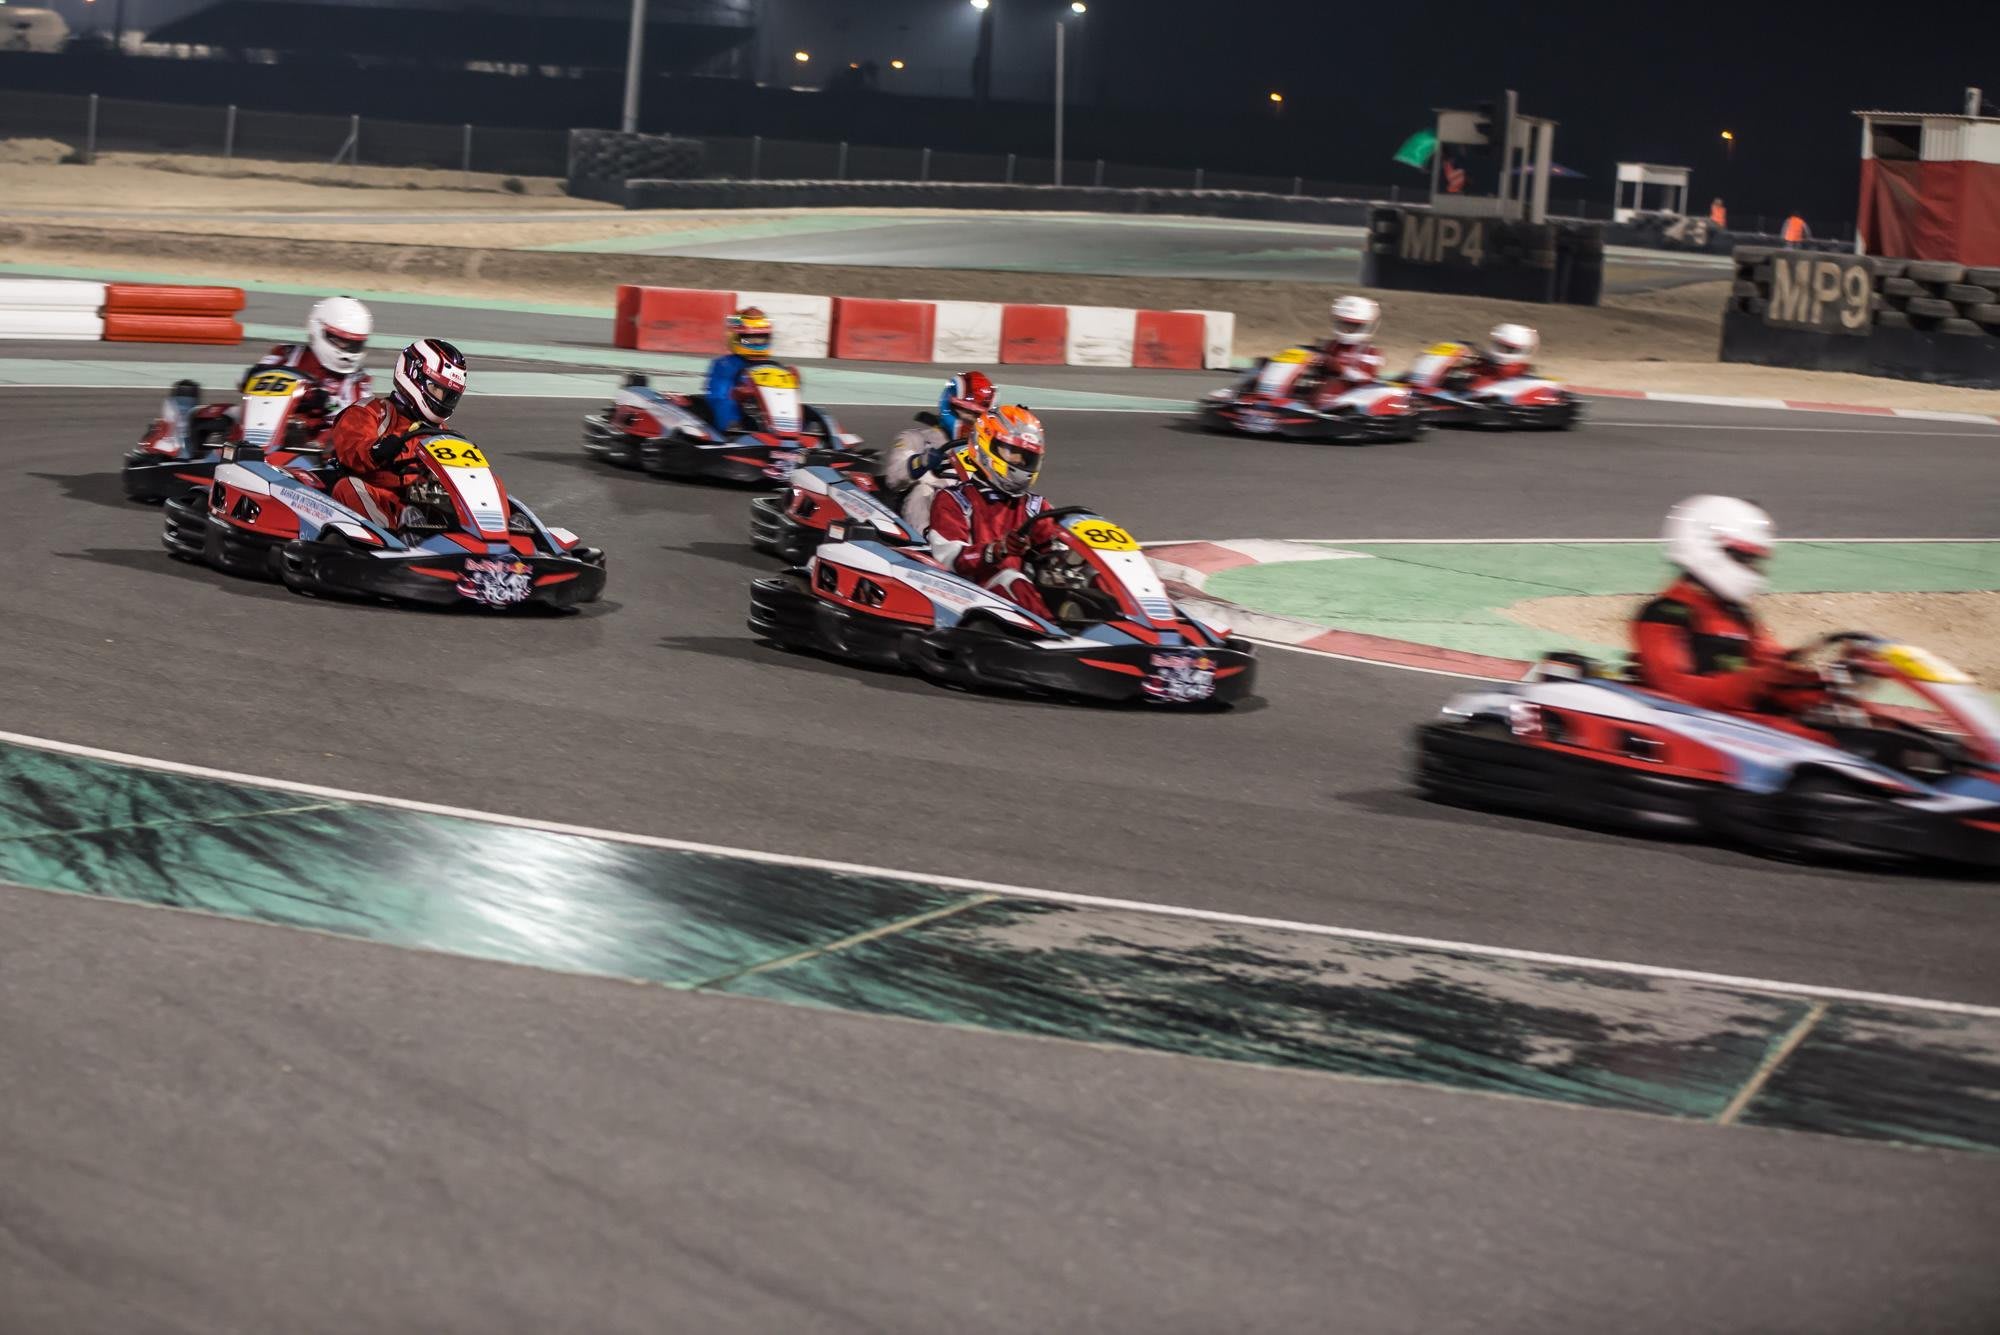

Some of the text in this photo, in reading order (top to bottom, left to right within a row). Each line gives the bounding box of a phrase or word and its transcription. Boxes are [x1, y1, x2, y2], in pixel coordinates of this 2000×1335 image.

[1400, 214, 1484, 266] MP4
[1769, 259, 1869, 328] MP9
[254, 375, 297, 391] 66
[433, 447, 482, 463] 84
[1084, 529, 1128, 543] 80
